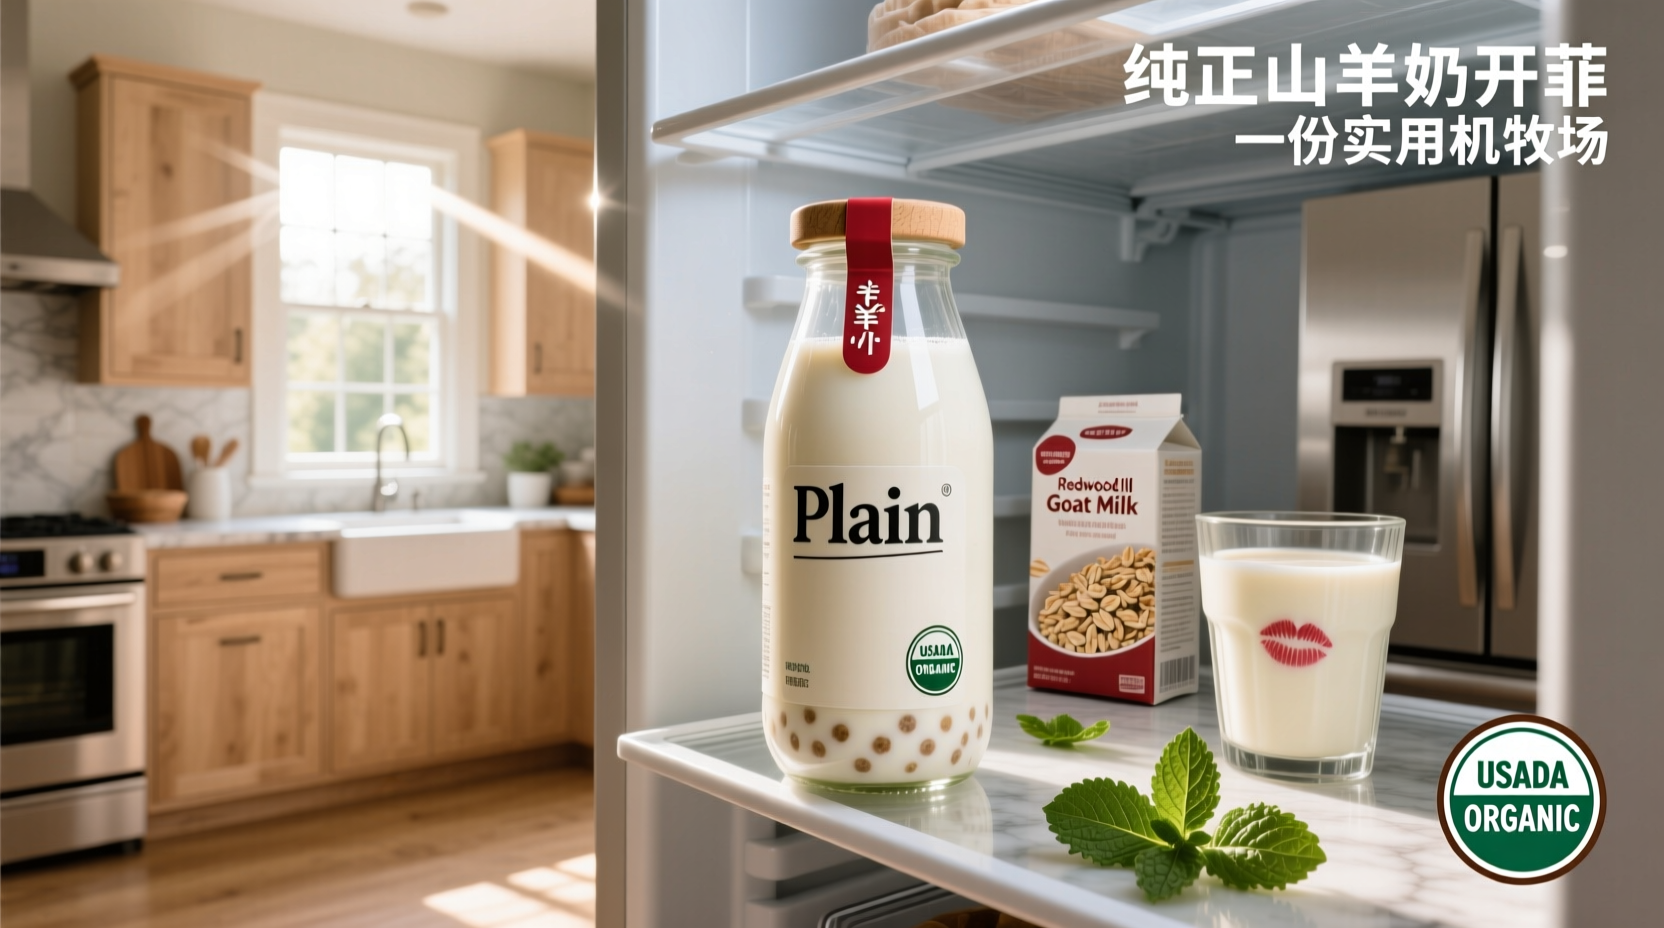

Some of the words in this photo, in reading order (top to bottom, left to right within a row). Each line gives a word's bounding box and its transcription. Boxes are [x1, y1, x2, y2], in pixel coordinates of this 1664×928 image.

[793, 482, 944, 545] Plain
[1046, 493, 1092, 514] Goat
[1096, 495, 1139, 516] Milk
